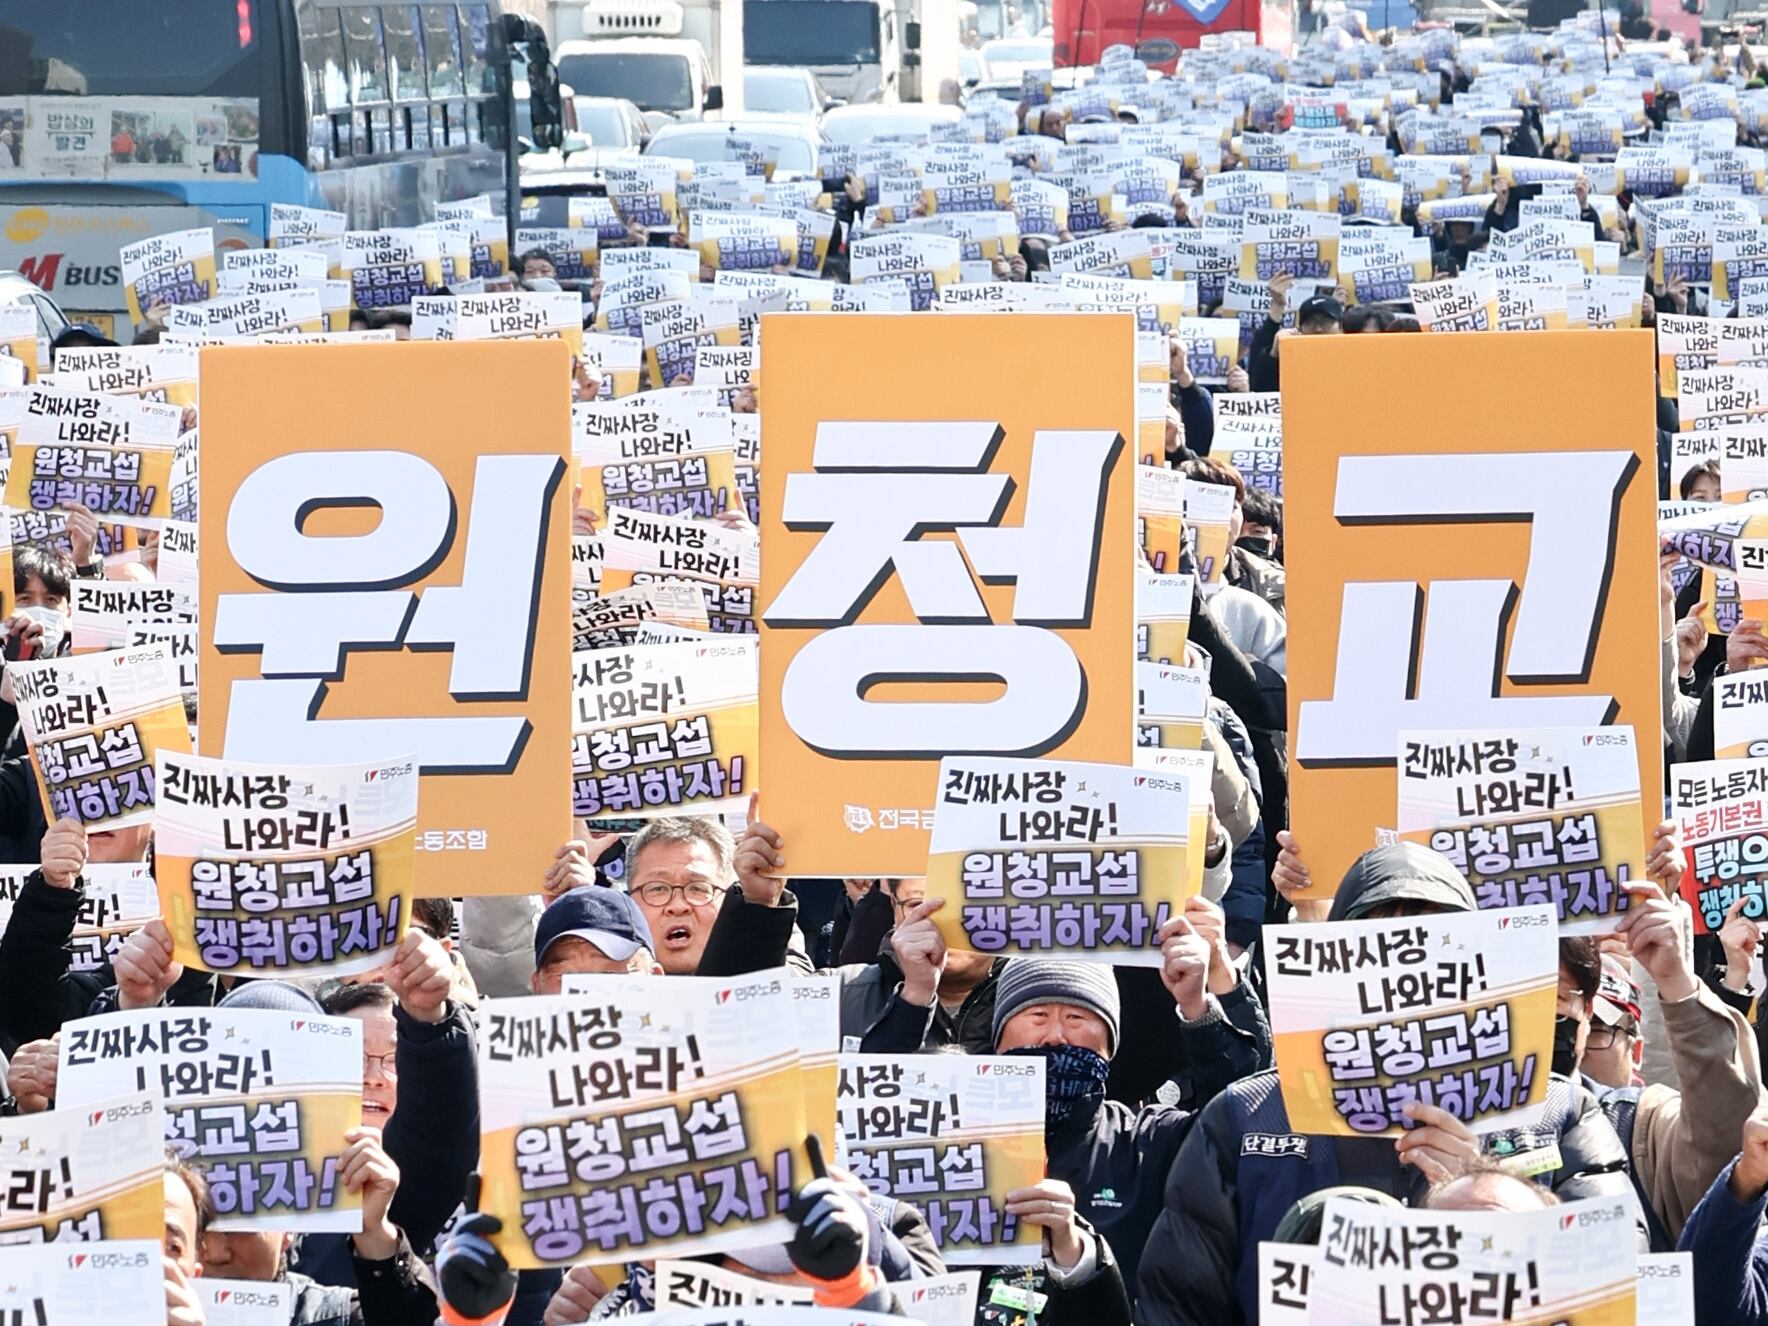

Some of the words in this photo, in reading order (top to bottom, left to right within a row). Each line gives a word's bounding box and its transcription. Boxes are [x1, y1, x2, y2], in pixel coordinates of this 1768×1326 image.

[65, 265, 120, 286] BUS
[208, 299, 260, 325] 진짜사장
[235, 308, 288, 335] 나와라!
[461, 297, 521, 320] 진짜사장
[490, 308, 549, 333] 나와라!
[58, 353, 121, 372] 진짜사장
[88, 365, 153, 392] 나와라!
[1682, 374, 1734, 394] 진짜사장
[1707, 389, 1759, 412] 나와라!
[27, 391, 101, 419] 진짜사장
[586, 413, 658, 435] 진짜사장
[58, 421, 130, 445] 나와라!
[622, 429, 692, 457] 나와라!
[33, 445, 142, 482] 원청교섭
[602, 457, 708, 495] 원청교섭
[29, 478, 157, 516] 쟁취하자!
[614, 514, 706, 548] 진짜사장
[660, 550, 739, 579] 나와라!
[78, 588, 175, 615] 진짜사장
[213, 450, 568, 775] 원
[761, 420, 1126, 761] 청
[1296, 450, 1641, 769] 교
[33, 686, 111, 734] 나와라!
[579, 675, 686, 723] 나와라!
[1404, 739, 1519, 779] 진짜사장
[162, 762, 290, 810] 진짜사장
[944, 769, 1065, 805] 진짜사장
[1457, 767, 1575, 819] 나와라!
[1677, 778, 1708, 808] 모든
[223, 804, 349, 853] 나와라!
[1000, 803, 1118, 843] 나와라!
[1681, 799, 1763, 841] 노동기본권
[1430, 812, 1600, 876] 원청교섭
[191, 849, 375, 914] 원청교섭
[962, 848, 1140, 899] 원청교섭
[194, 895, 399, 969] 쟁취하자!
[962, 903, 1172, 951] 쟁취하자!
[1274, 926, 1428, 976] 진짜사장
[1359, 954, 1488, 1016] 나와라!
[67, 1017, 211, 1065] 진짜사장
[488, 1007, 622, 1063] 진짜사장
[1322, 1003, 1512, 1081] 원청교섭
[136, 1050, 275, 1098] 나와라!
[548, 1035, 705, 1109] 나와라!
[1334, 1055, 1534, 1133] 쟁취하자!
[514, 1094, 748, 1193] 원청교섭
[1244, 1136, 1306, 1158] 단결투쟁
[521, 1150, 793, 1262] 쟁취하자!
[1325, 1214, 1461, 1272] 진짜사장
